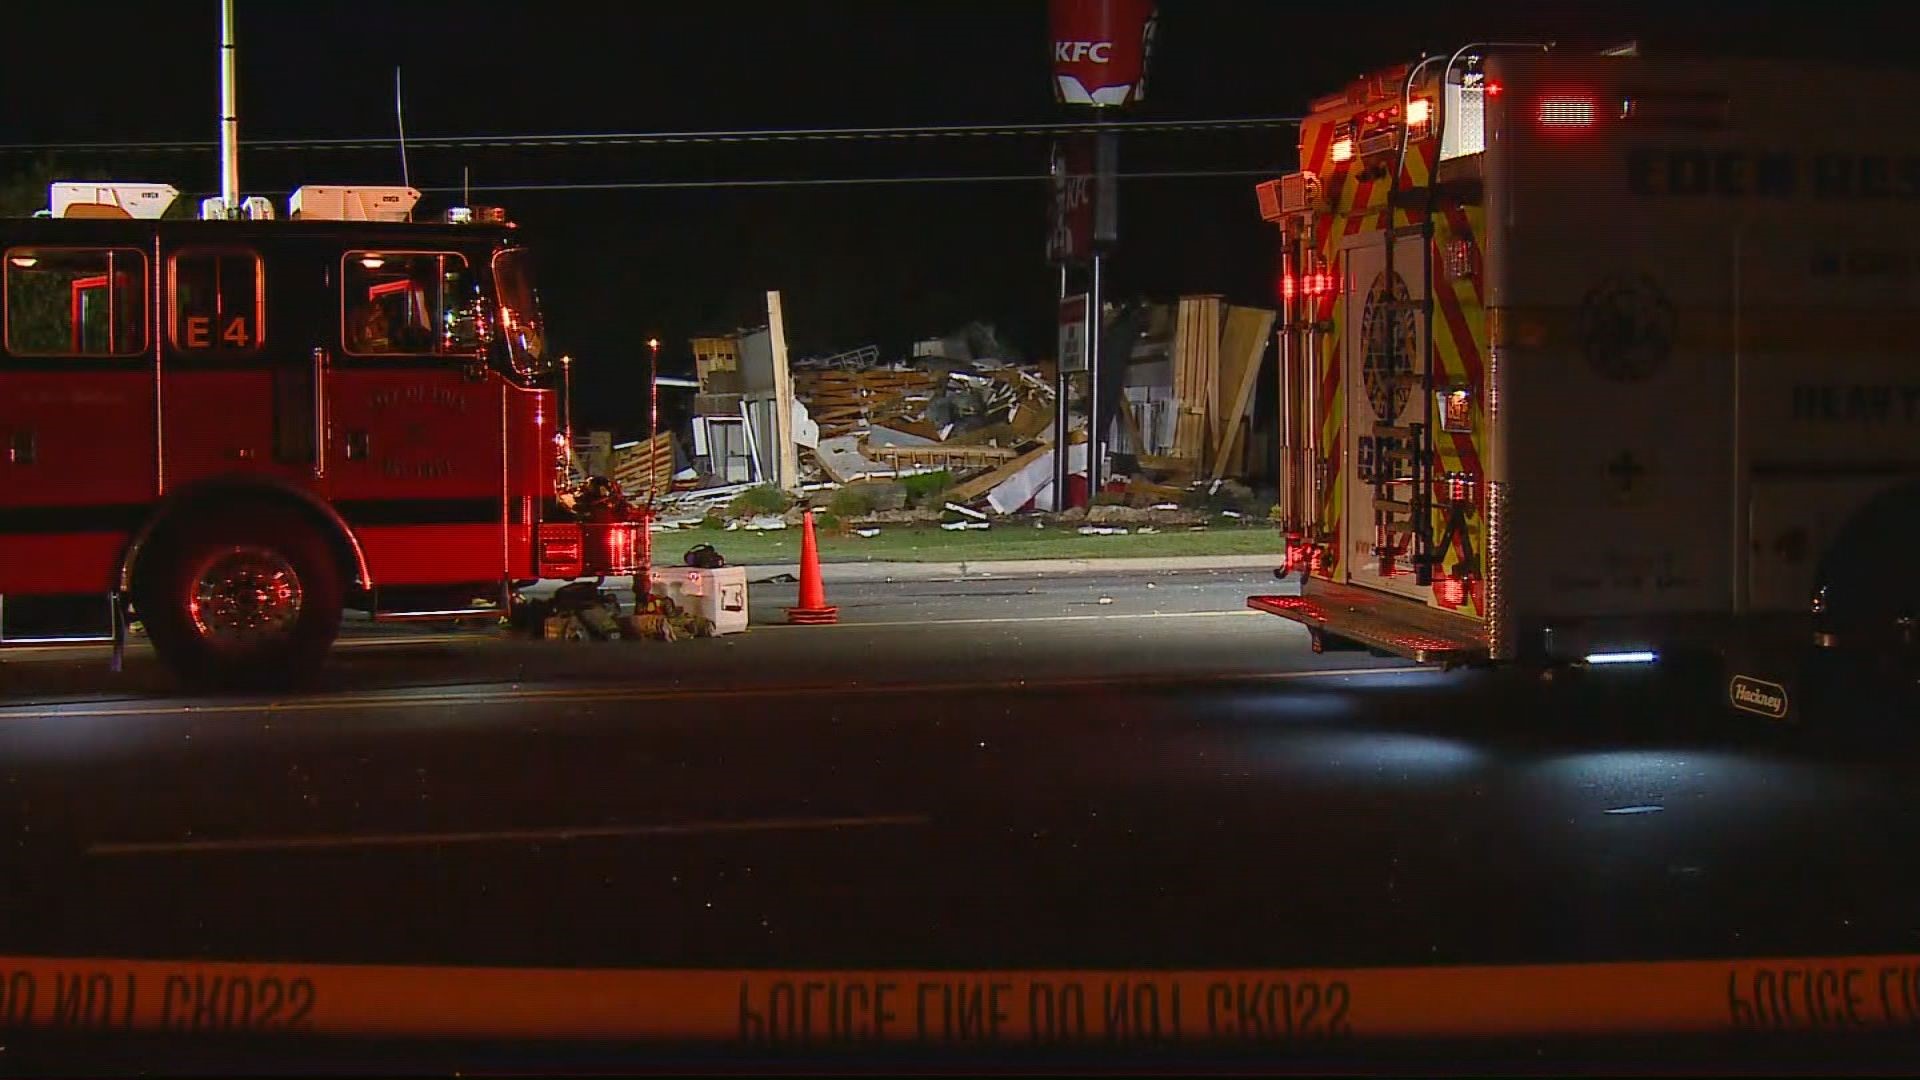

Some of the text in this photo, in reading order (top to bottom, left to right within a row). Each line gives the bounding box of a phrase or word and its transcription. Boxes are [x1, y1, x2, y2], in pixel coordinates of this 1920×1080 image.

[1055, 41, 1112, 64] KFC
[187, 315, 248, 349] E 4
[1735, 684, 1781, 712] Hackney
